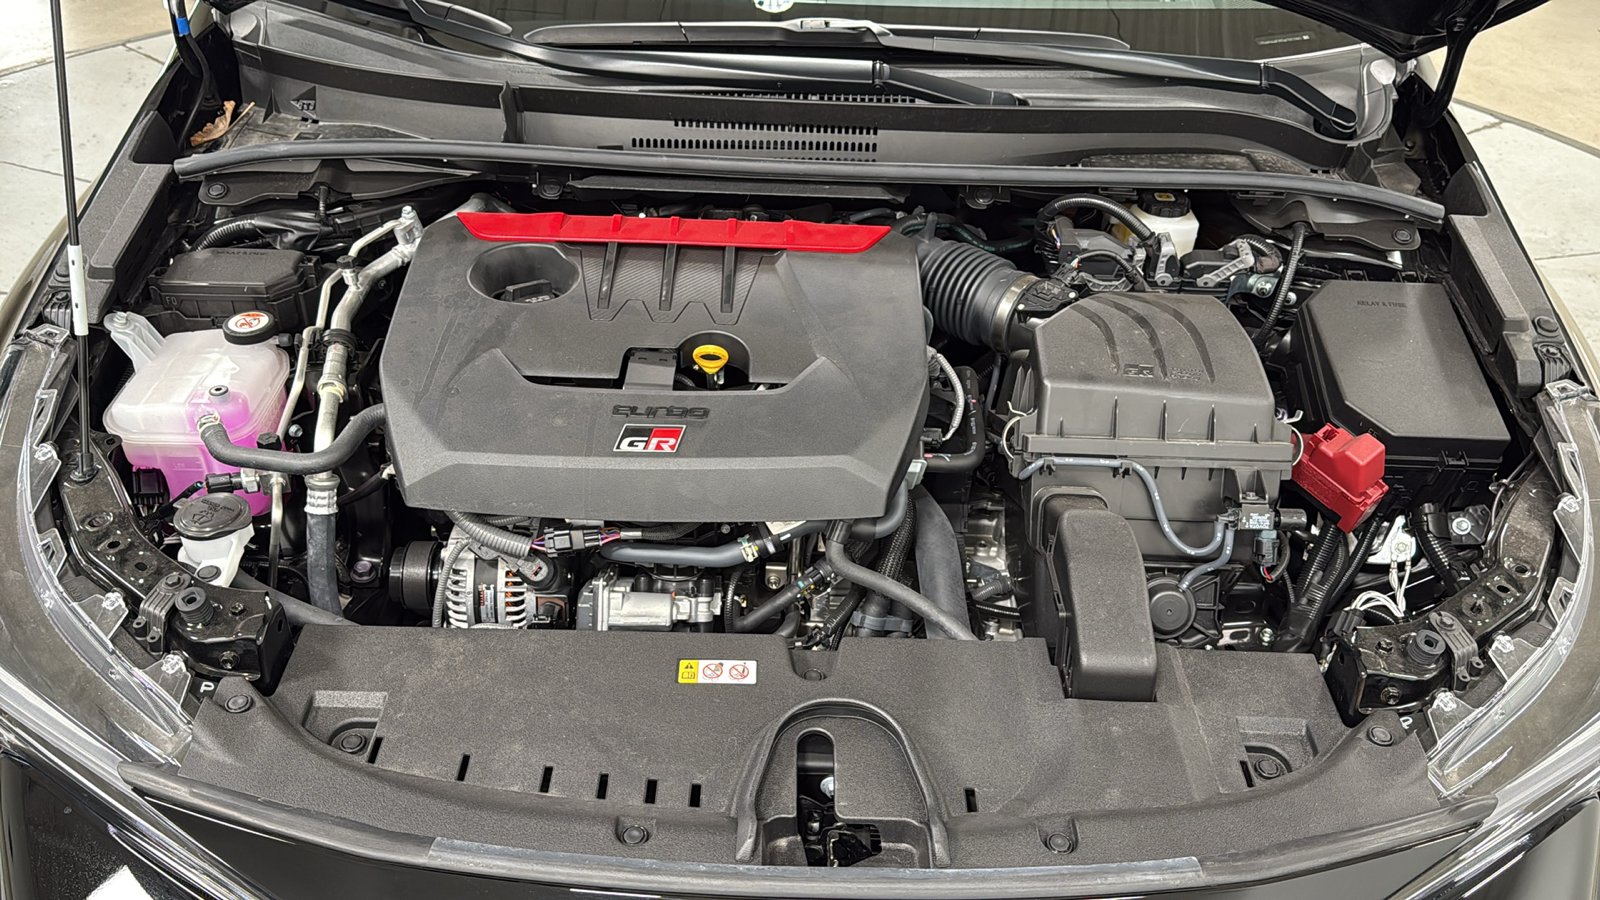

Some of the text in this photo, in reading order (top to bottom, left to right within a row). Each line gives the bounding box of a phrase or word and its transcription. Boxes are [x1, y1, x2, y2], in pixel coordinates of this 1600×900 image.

[1388, 301, 1408, 309] FUSE
[619, 436, 676, 451] GR
[199, 681, 215, 693] P
